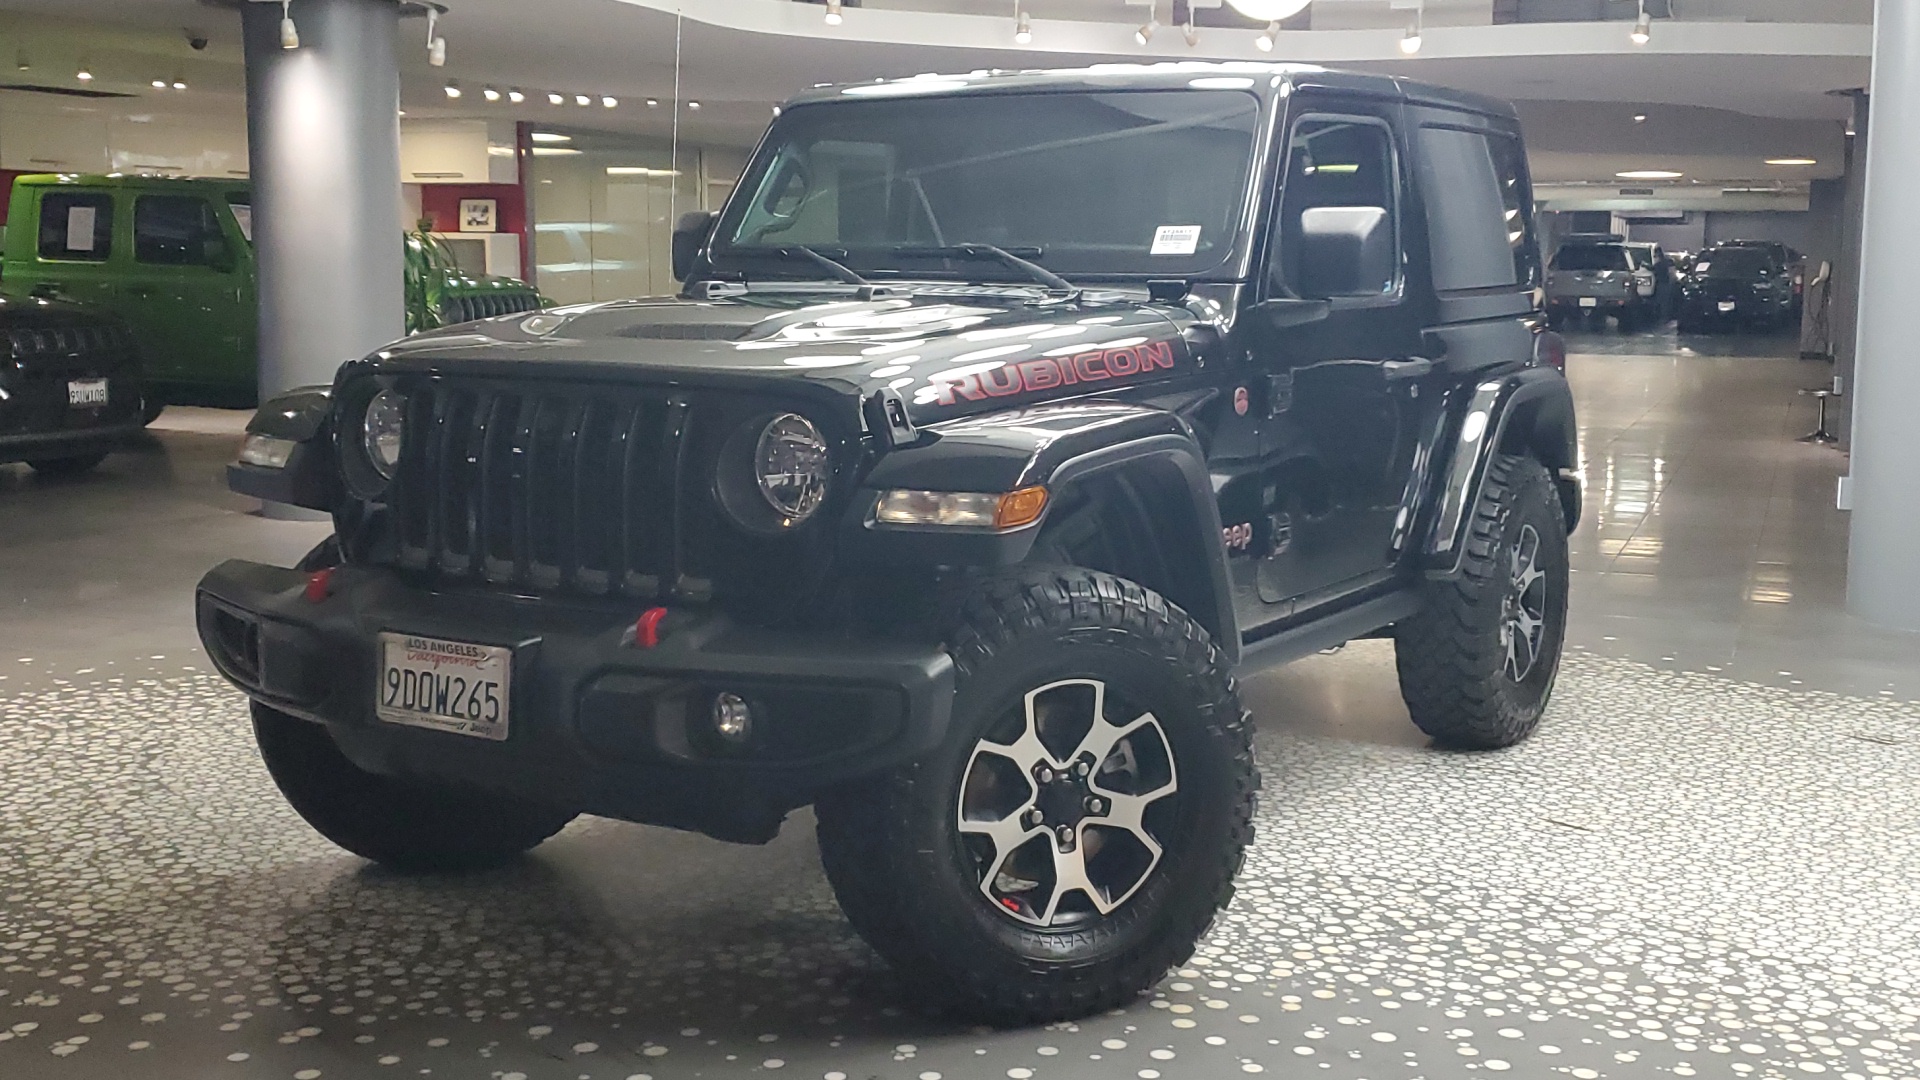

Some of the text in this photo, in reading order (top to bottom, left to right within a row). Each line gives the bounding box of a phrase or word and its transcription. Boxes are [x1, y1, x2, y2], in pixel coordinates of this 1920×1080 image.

[931, 342, 1174, 406] RUBICON
[1222, 522, 1252, 550] eep
[408, 638, 479, 658] LOS ANGELES
[385, 667, 500, 724] 9DOW265
